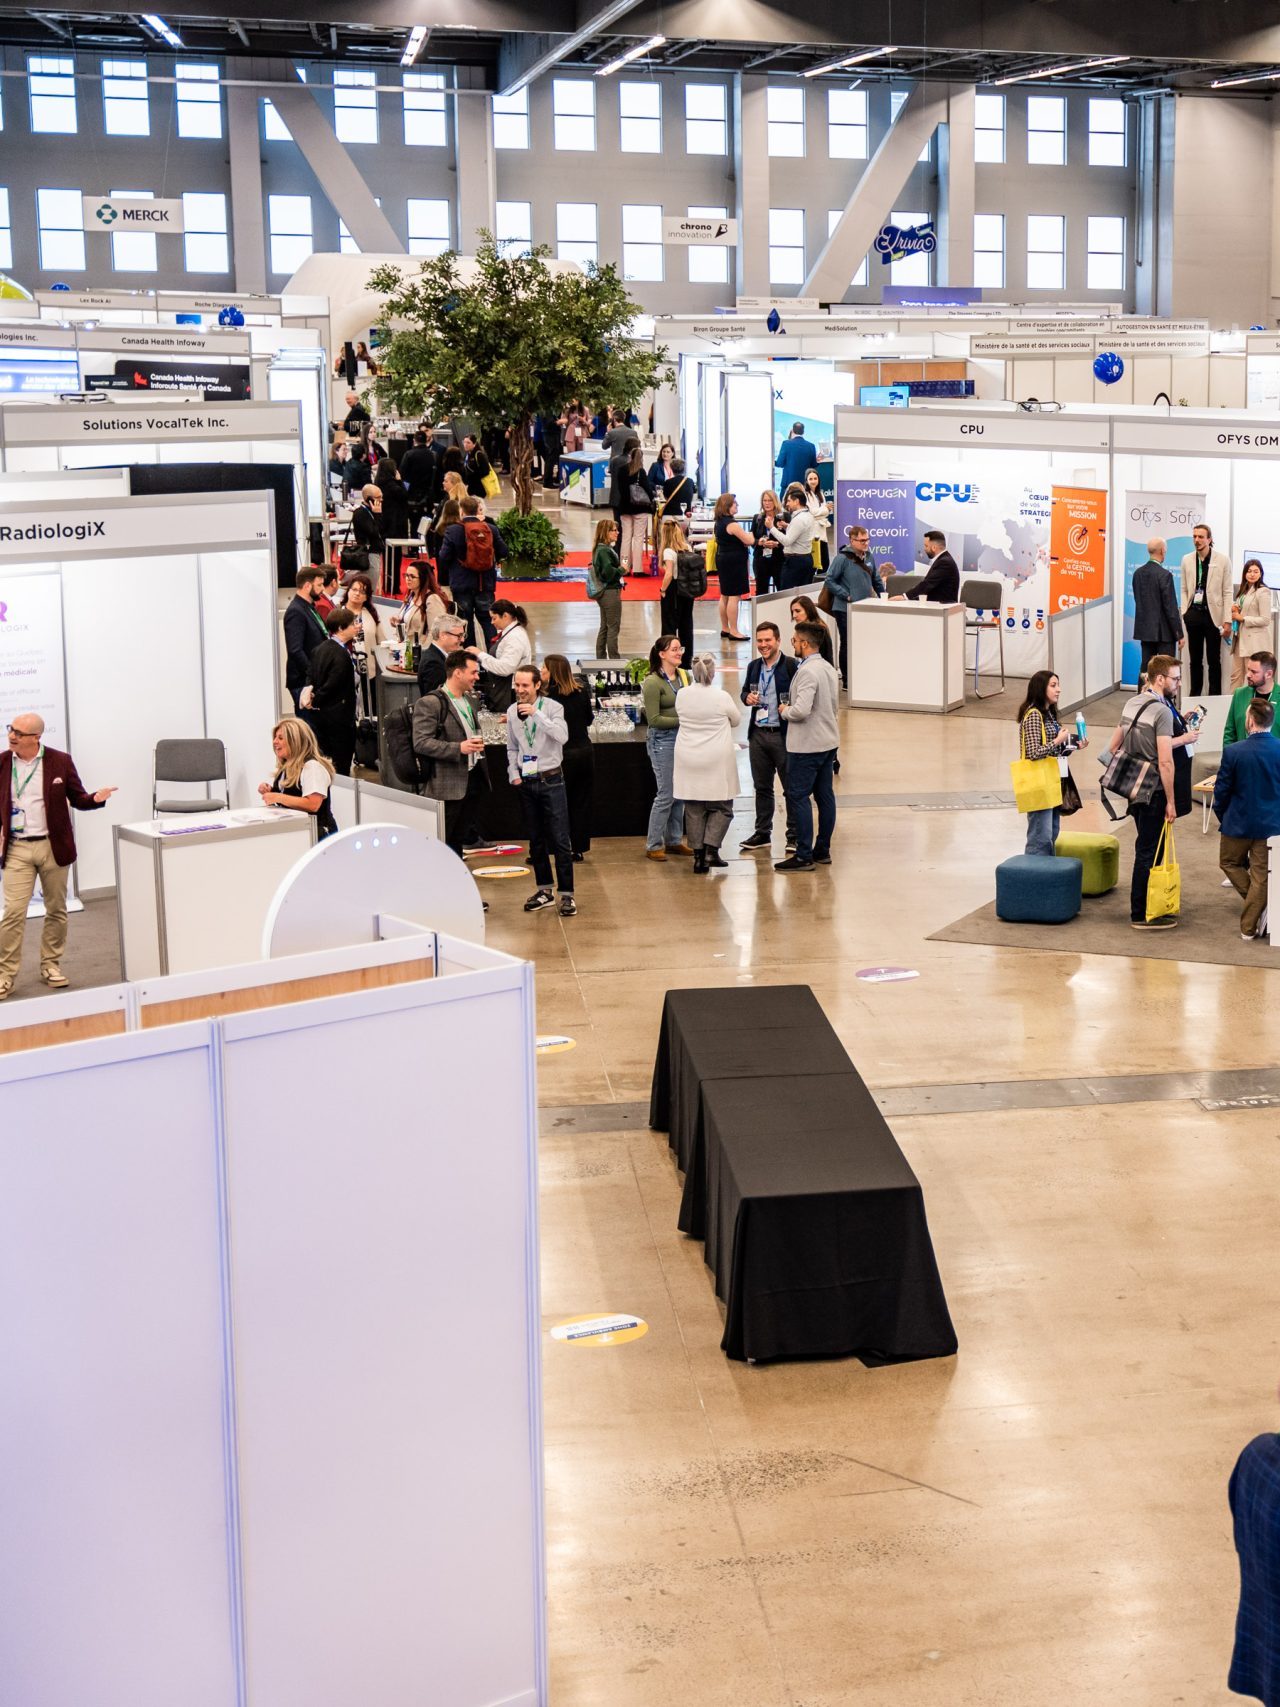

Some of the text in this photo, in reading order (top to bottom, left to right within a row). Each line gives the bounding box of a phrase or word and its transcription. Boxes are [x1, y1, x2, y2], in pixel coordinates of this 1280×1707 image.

[122, 209, 169, 221] MERCK
[680, 223, 712, 231] chrono
[668, 231, 712, 239] innovation
[709, 326, 729, 334] Groupe
[121, 337, 149, 345] Canada
[177, 338, 206, 348] Infoway
[150, 373, 220, 384] Canada Health Infoway
[151, 382, 231, 392] Inforoute Santé du Canada
[83, 418, 229, 431] Solutions VocalTek Inc.
[960, 424, 984, 435] CPU
[1217, 434, 1251, 445] OFYS
[846, 488, 907, 499] COMPUGEN
[916, 482, 972, 503] CPU
[858, 506, 895, 520] Rêver.
[1069, 510, 1097, 520] MISSION
[1131, 508, 1161, 527] Ofys
[0, 521, 106, 541] RadiologiX
[1072, 564, 1095, 573] GESTION
